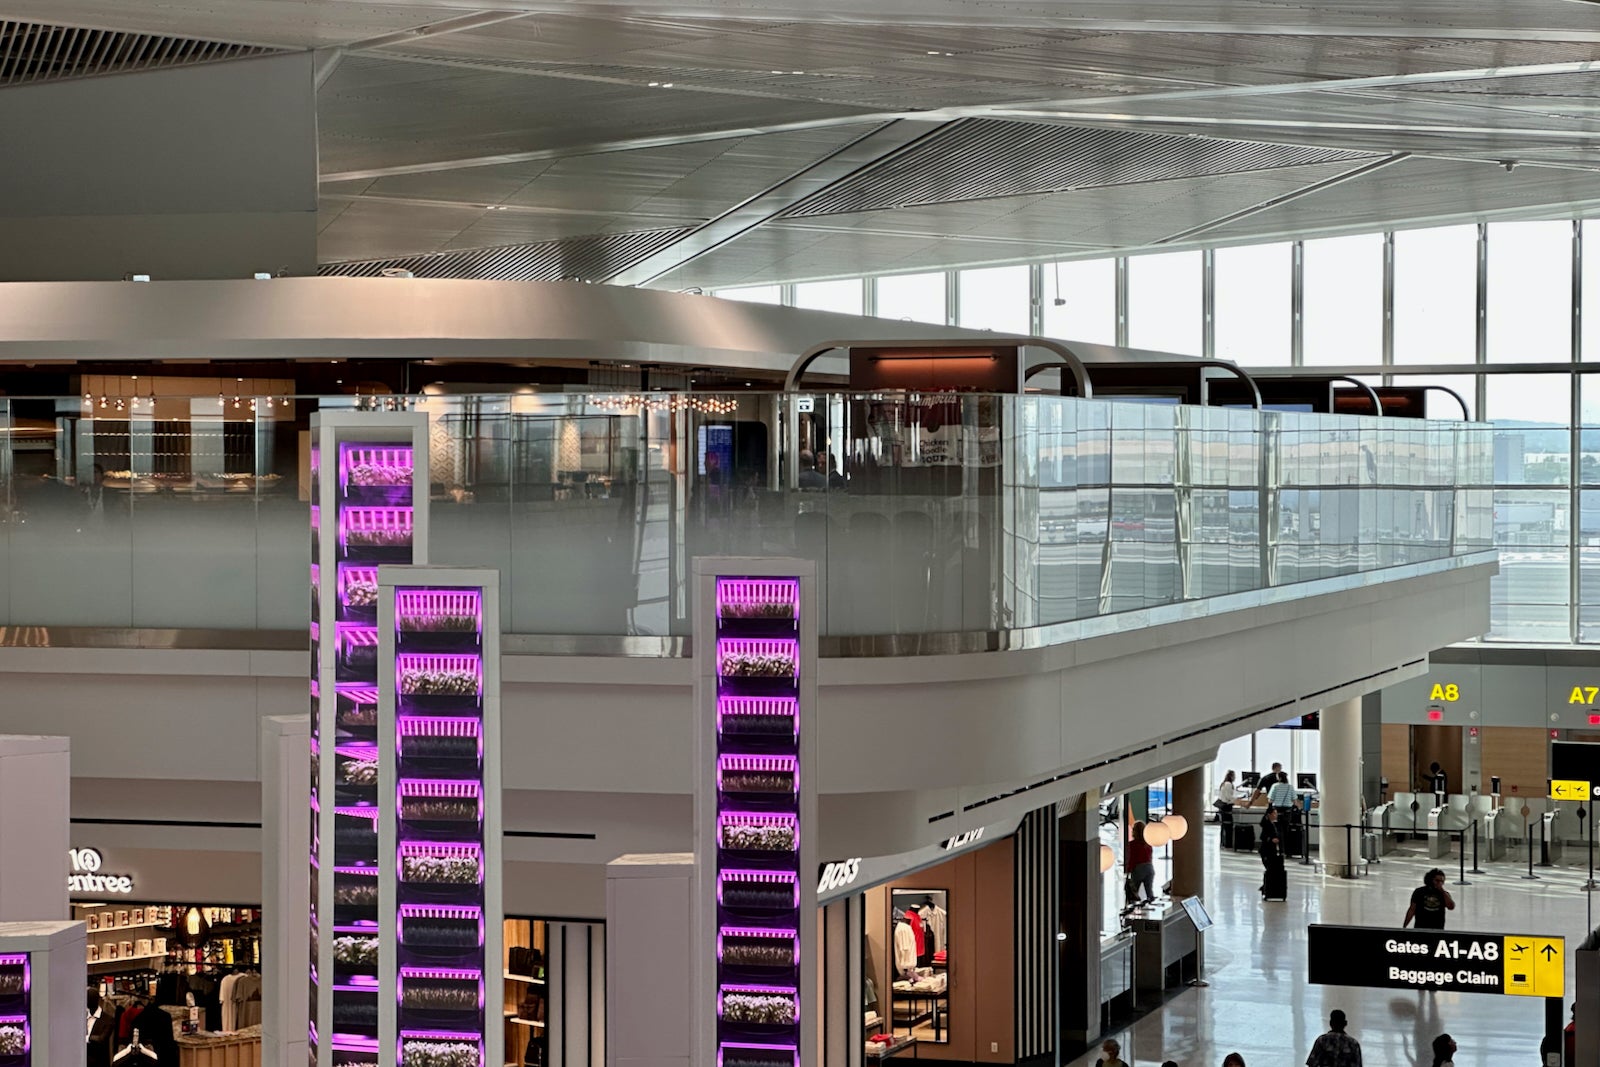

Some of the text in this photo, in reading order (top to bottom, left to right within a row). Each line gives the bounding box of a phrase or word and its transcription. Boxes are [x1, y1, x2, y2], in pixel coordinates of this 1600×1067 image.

[1430, 683, 1460, 702] A8
[1568, 686, 1600, 704] A7
[68, 848, 101, 872] 10
[817, 857, 862, 894] BOSS
[1385, 939, 1499, 961] Gates A1-A8
[1389, 966, 1499, 985] Baggage Claim
